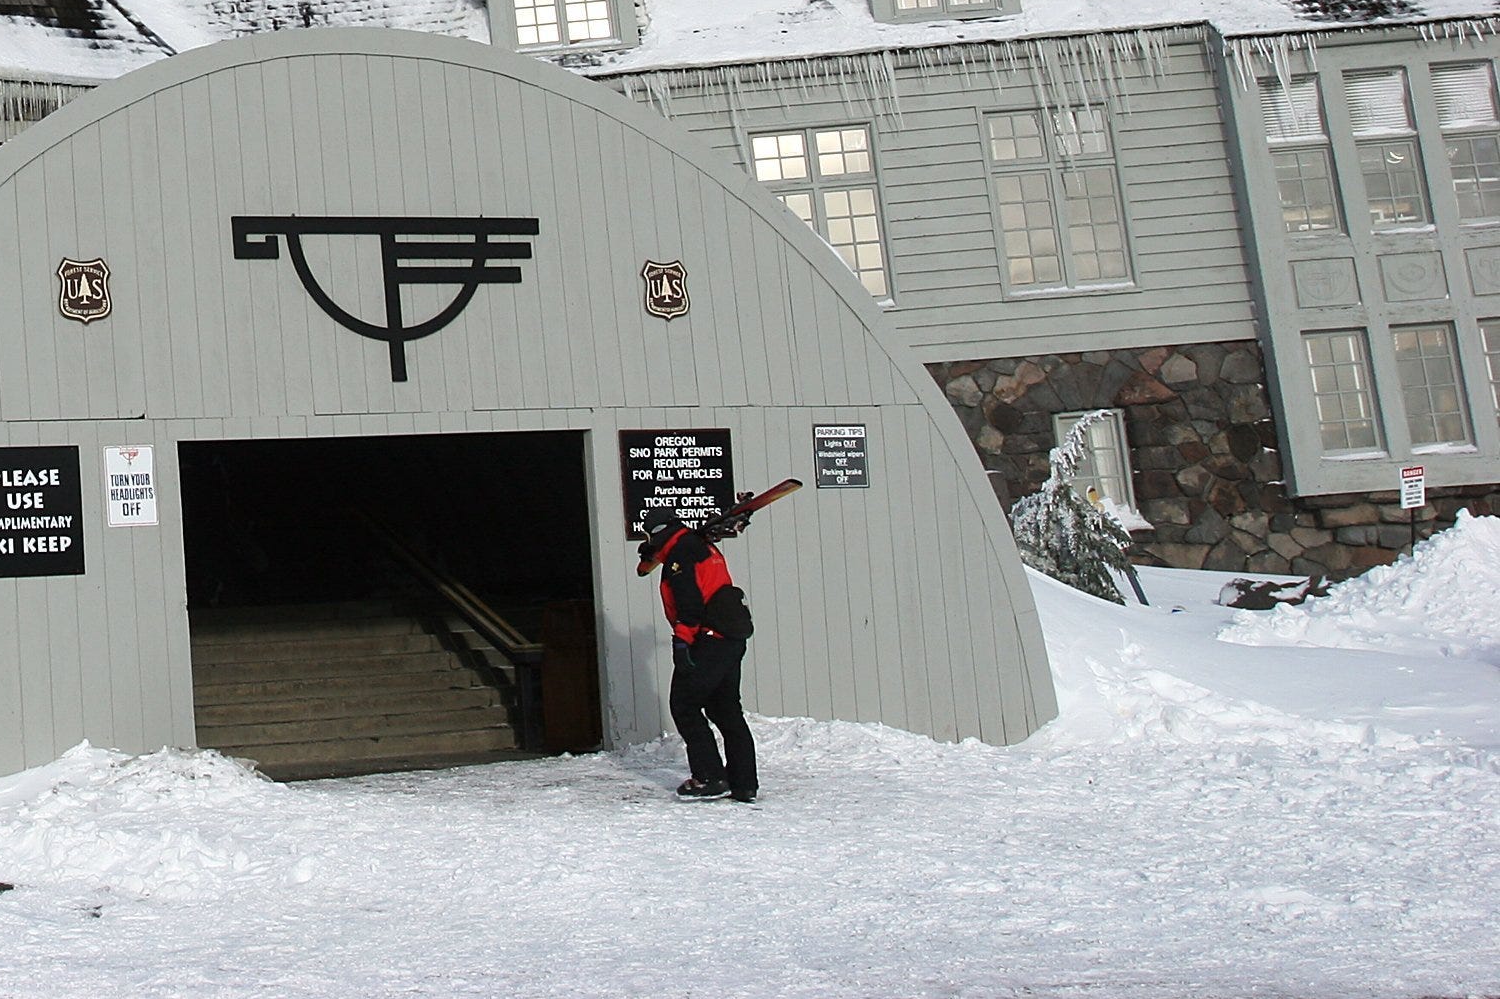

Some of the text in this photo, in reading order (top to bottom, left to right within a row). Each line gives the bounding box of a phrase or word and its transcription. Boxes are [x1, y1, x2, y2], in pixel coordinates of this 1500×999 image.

[816, 428, 846, 436] PARKING
[655, 436, 696, 446] OREGON
[824, 440, 857, 448] Lights OUT
[629, 446, 723, 458] SNO PARK PERMITS
[653, 458, 701, 468] REQUIRED
[835, 458, 848, 466] OFF
[632, 468, 723, 480] FOR ALL VEHICLES
[822, 468, 844, 476] Parking
[110, 473, 151, 487] TURN YOUR
[836, 476, 849, 484] OFF
[110, 487, 154, 501] HEADLIGHTS
[654, 486, 692, 495] Purchase
[6, 492, 44, 510] USE
[644, 496, 715, 507] TICKET OFFICE
[122, 502, 141, 516] OFF
[23, 536, 72, 554] KEEP
